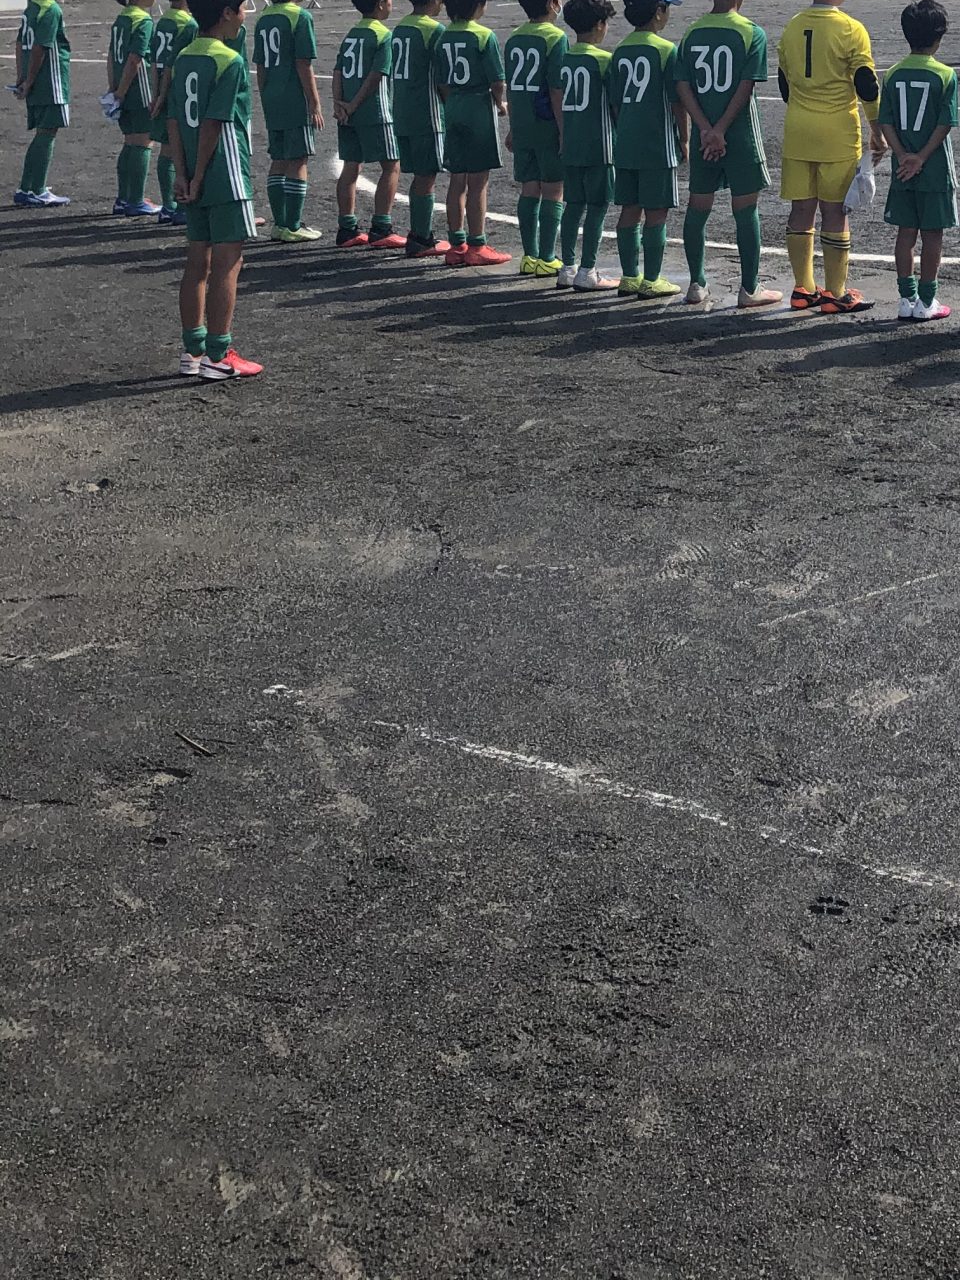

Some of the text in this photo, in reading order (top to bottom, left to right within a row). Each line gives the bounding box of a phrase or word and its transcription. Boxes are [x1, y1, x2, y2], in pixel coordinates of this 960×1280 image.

[259, 26, 281, 68] 19
[341, 37, 364, 80] 31
[391, 37, 411, 80] 21
[442, 42, 471, 86] 15
[510, 47, 540, 92] 22
[690, 45, 733, 94] 30
[803, 29, 813, 78] 1
[184, 71, 199, 128] 8
[560, 66, 590, 112] 20
[618, 55, 651, 104] 29
[895, 81, 931, 132] 17
